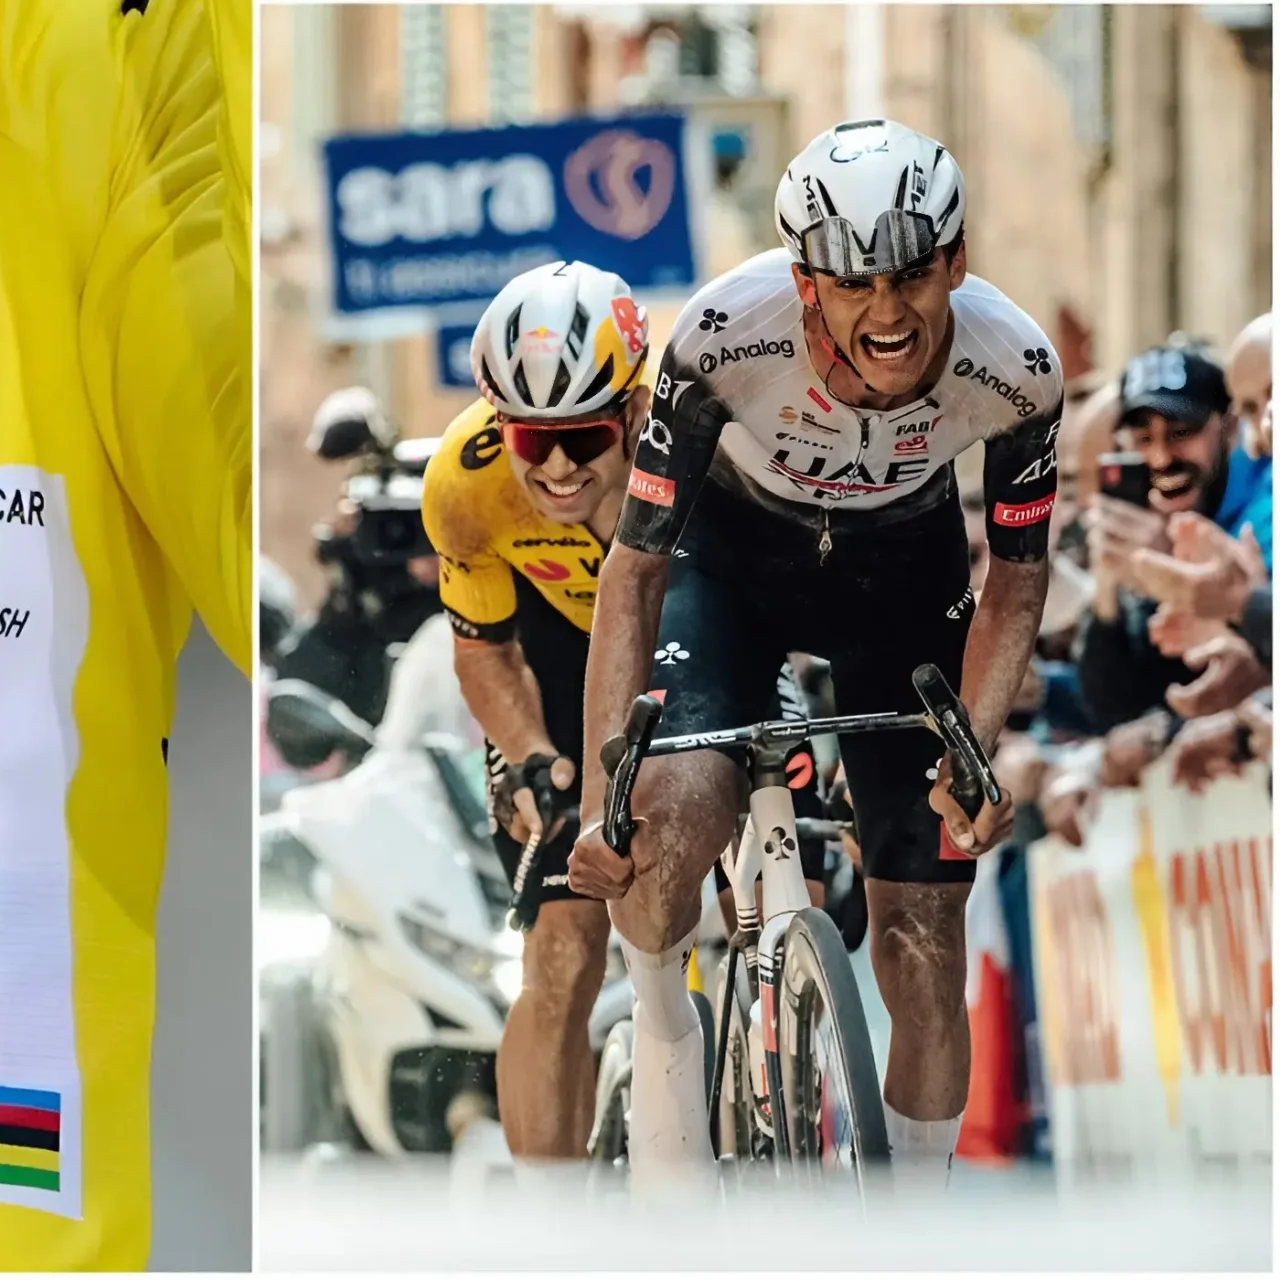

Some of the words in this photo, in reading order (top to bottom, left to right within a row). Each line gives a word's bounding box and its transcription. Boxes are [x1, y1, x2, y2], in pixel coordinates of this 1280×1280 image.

[336, 153, 556, 246] sara
[720, 337, 795, 367] Analog
[973, 366, 1037, 417] Analog
[772, 449, 930, 485] UAE
